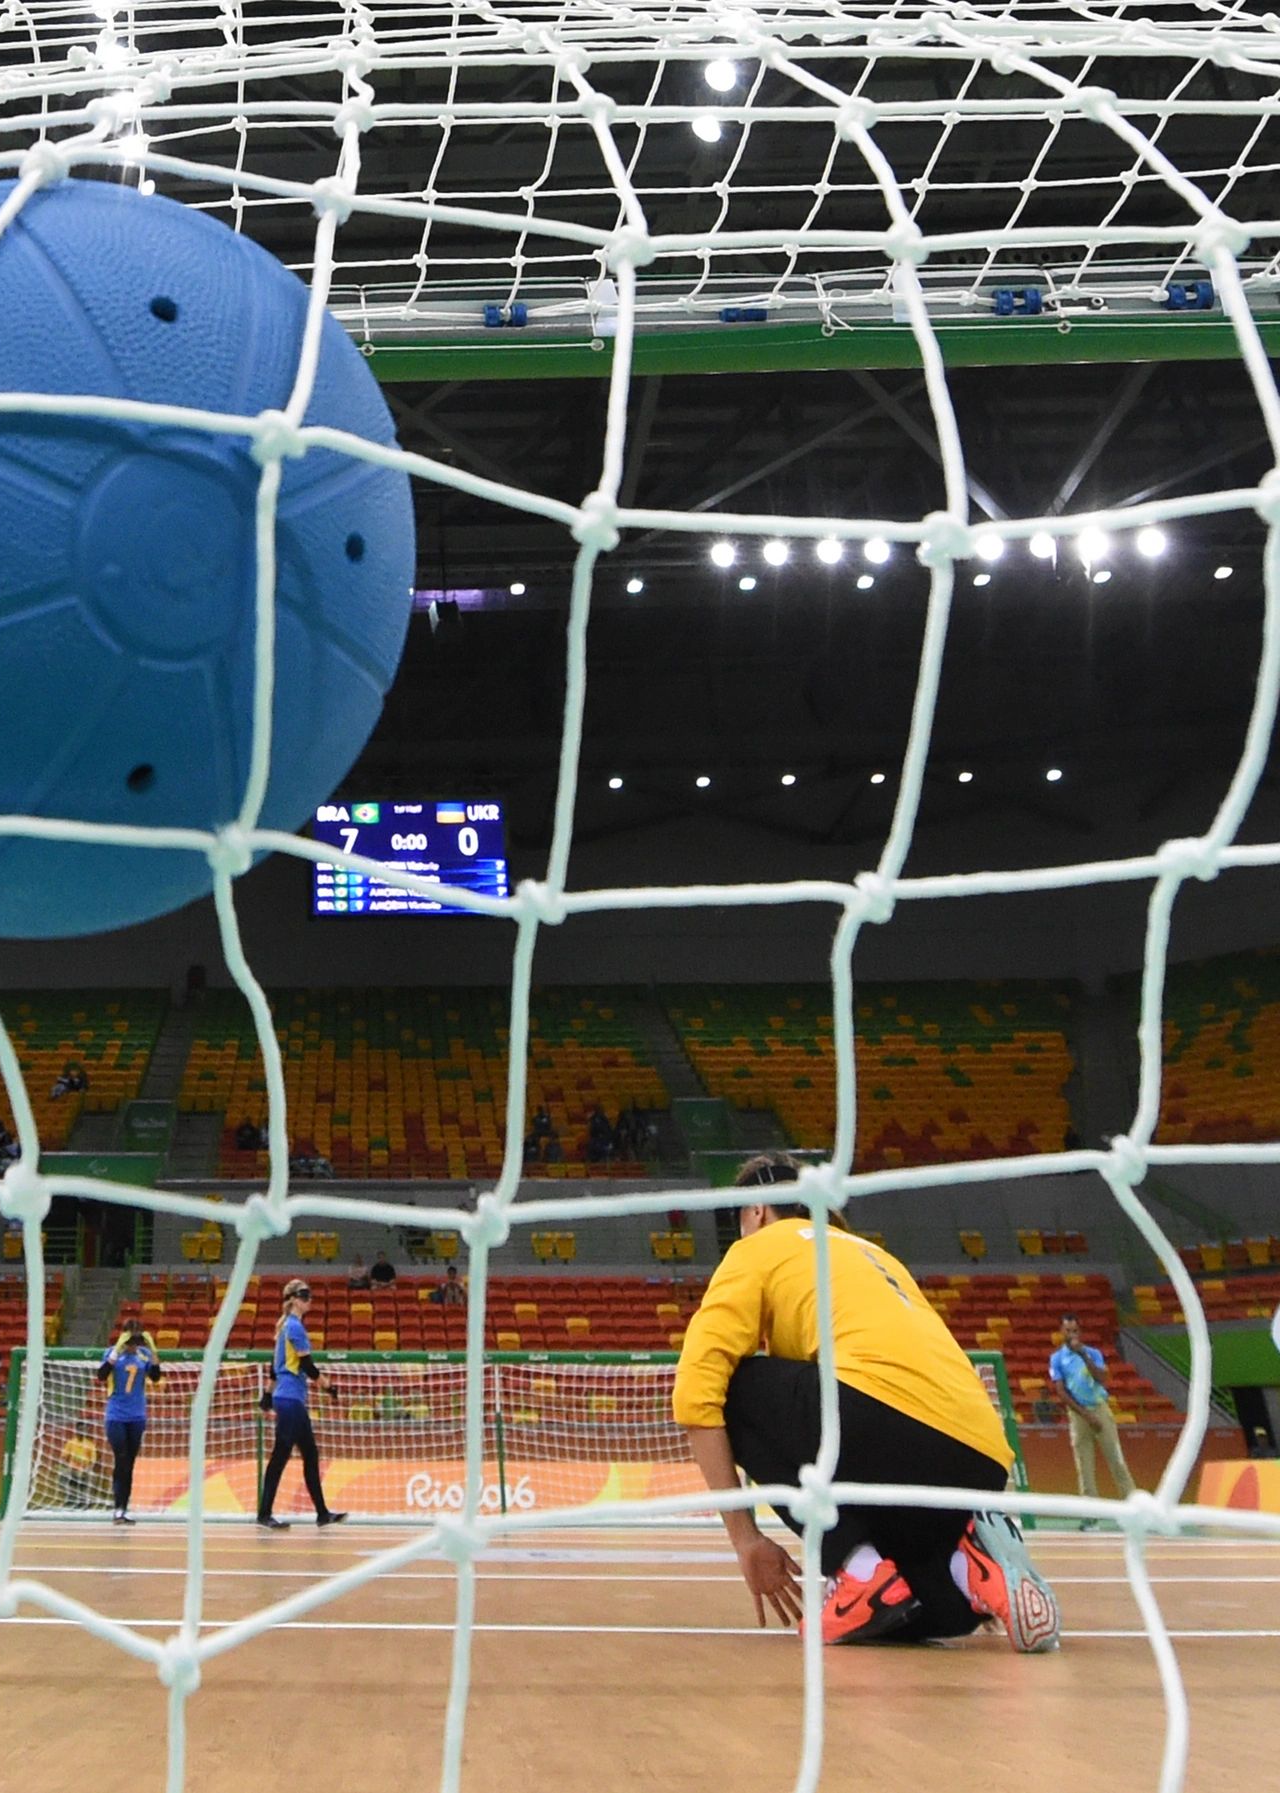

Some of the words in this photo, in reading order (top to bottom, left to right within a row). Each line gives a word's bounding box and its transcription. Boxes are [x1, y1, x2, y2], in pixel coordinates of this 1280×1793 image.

[317, 805, 350, 822] BRA
[467, 804, 500, 821] UKR
[340, 828, 359, 855] 7
[391, 833, 428, 851] 0:00
[458, 827, 479, 856] 0
[406, 1472, 536, 1509] Rio016
